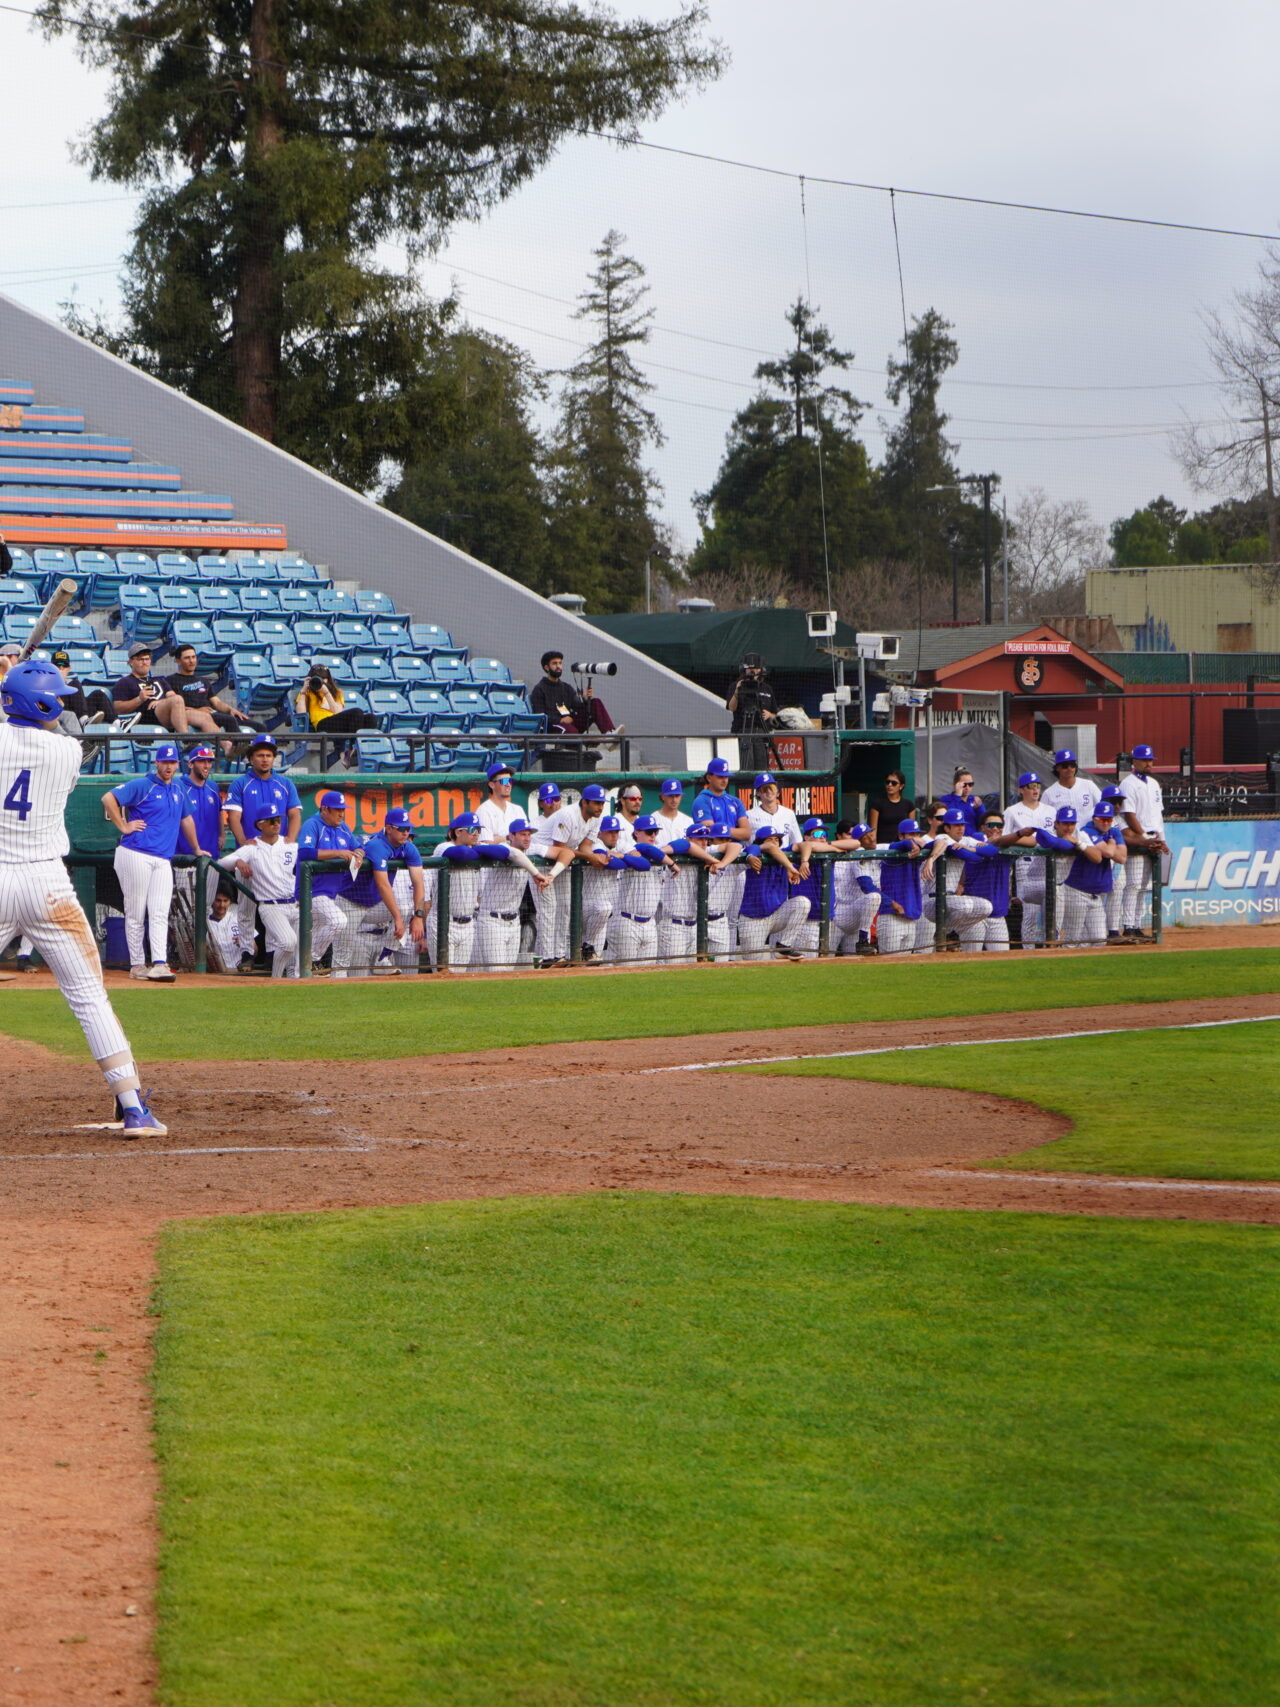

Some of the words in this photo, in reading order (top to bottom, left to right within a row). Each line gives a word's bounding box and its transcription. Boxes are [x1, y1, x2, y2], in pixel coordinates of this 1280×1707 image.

[3, 769, 33, 821] 4
[781, 787, 794, 814] WE
[795, 787, 811, 815] ARE
[811, 786, 835, 815] GIANT
[1170, 846, 1280, 892] LIGH
[1181, 897, 1280, 916] RESPONSI
